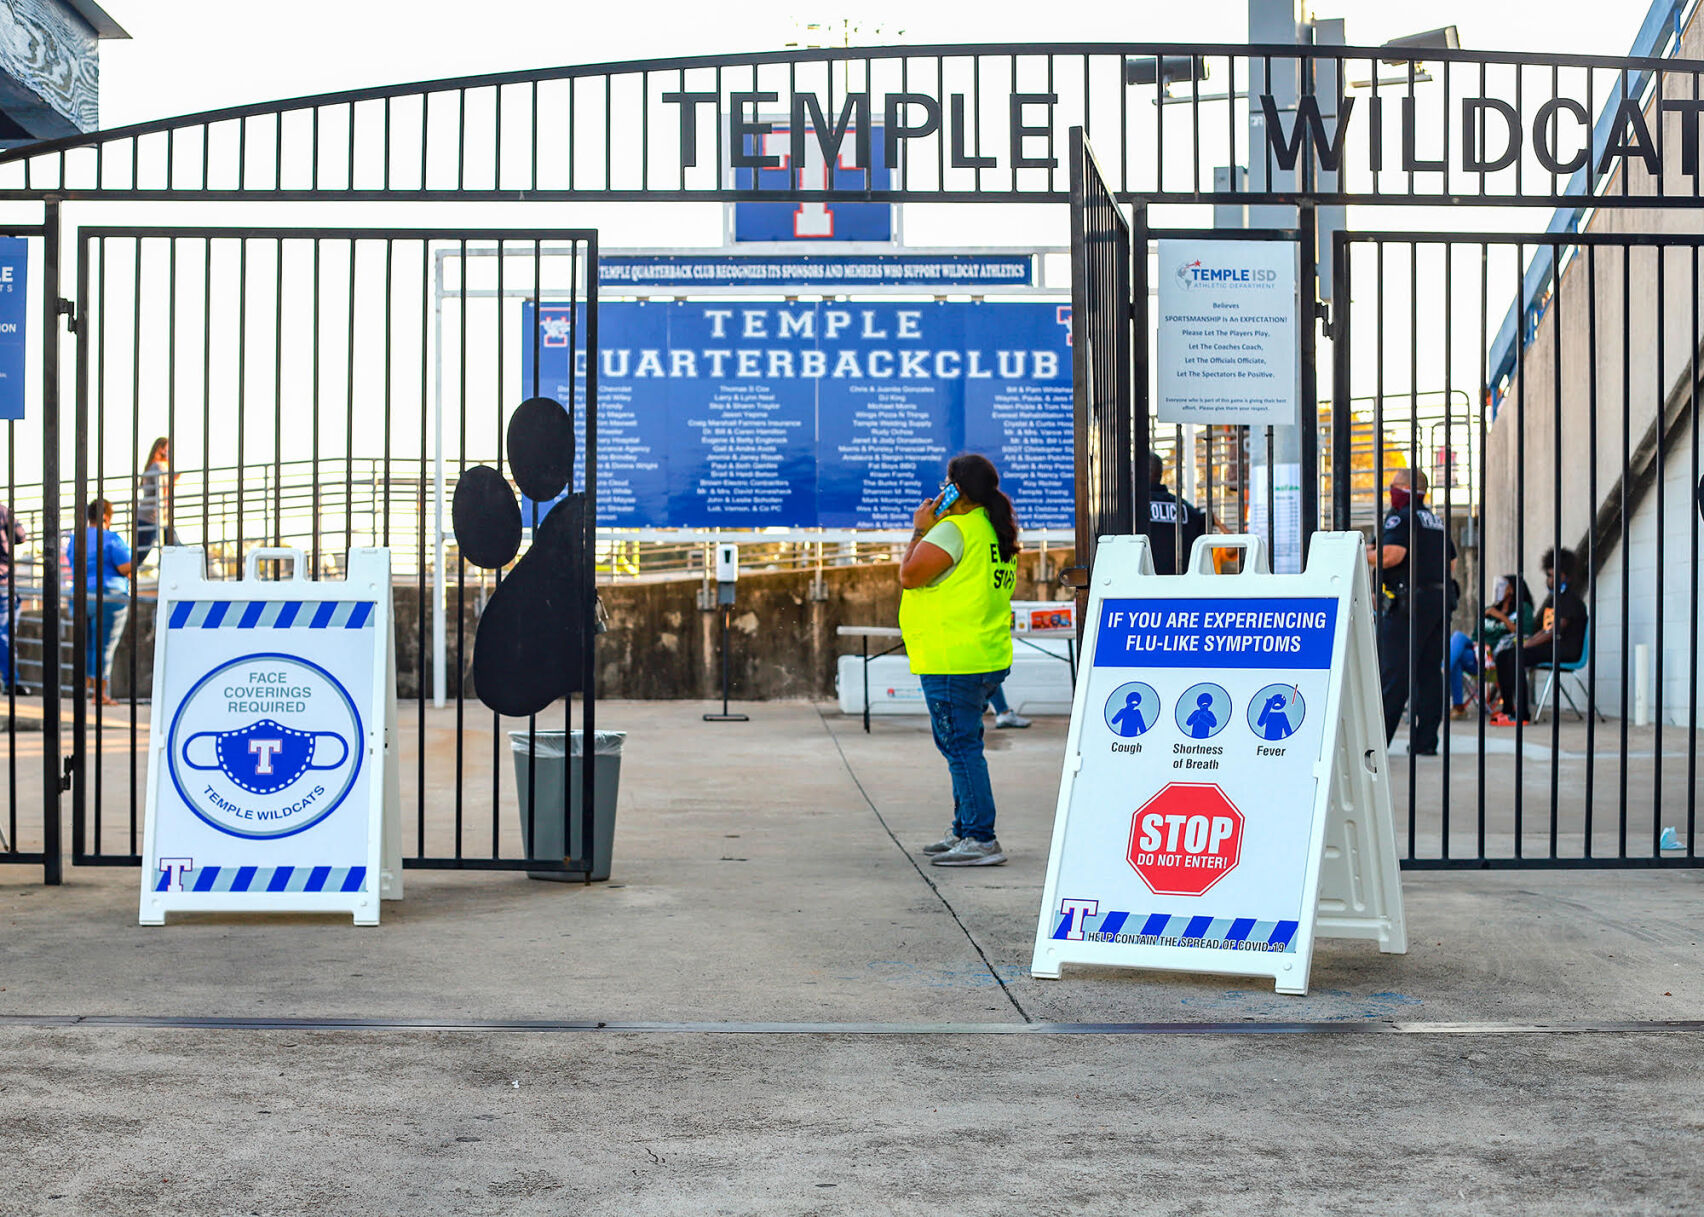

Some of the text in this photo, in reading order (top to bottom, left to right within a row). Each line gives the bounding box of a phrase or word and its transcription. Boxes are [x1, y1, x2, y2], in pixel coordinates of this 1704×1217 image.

[662, 91, 1704, 175] TEMPLE WILDCAT
[600, 264, 1025, 282] TEMPLE QUARTERBACK CLUB RECOGNIZES ITS SPONSORS AND MEMBERS WHO SUPPORT WILDCAT ATHLETICS
[1191, 269, 1277, 281] TEMPLE ISD
[705, 310, 922, 338] TEMPLE
[1237, 357, 1266, 365] Officiate,
[1151, 503, 1177, 521] OLIC
[1108, 612, 1326, 630] IF YOU ARE EXPERIENCING
[1126, 635, 1301, 653] FLU-LIKE SYMPTOMS
[249, 672, 287, 684] FACE
[224, 687, 312, 698] COVERINGS
[228, 701, 306, 713] REQUIRED
[249, 739, 282, 774] T
[1111, 742, 1143, 754] Cough
[1172, 743, 1223, 755] Shortness
[1256, 745, 1286, 757] Fever
[1172, 758, 1219, 770] of Breath
[203, 784, 326, 820] TEMPLE WILDCATS
[1139, 813, 1234, 854] STOP
[1137, 854, 1228, 869] DO NOT ENTER!
[159, 857, 193, 892] T
[1061, 898, 1099, 941] T
[1087, 932, 1285, 953] HELP CONTAIN THE SPREAD OF COVID-19
